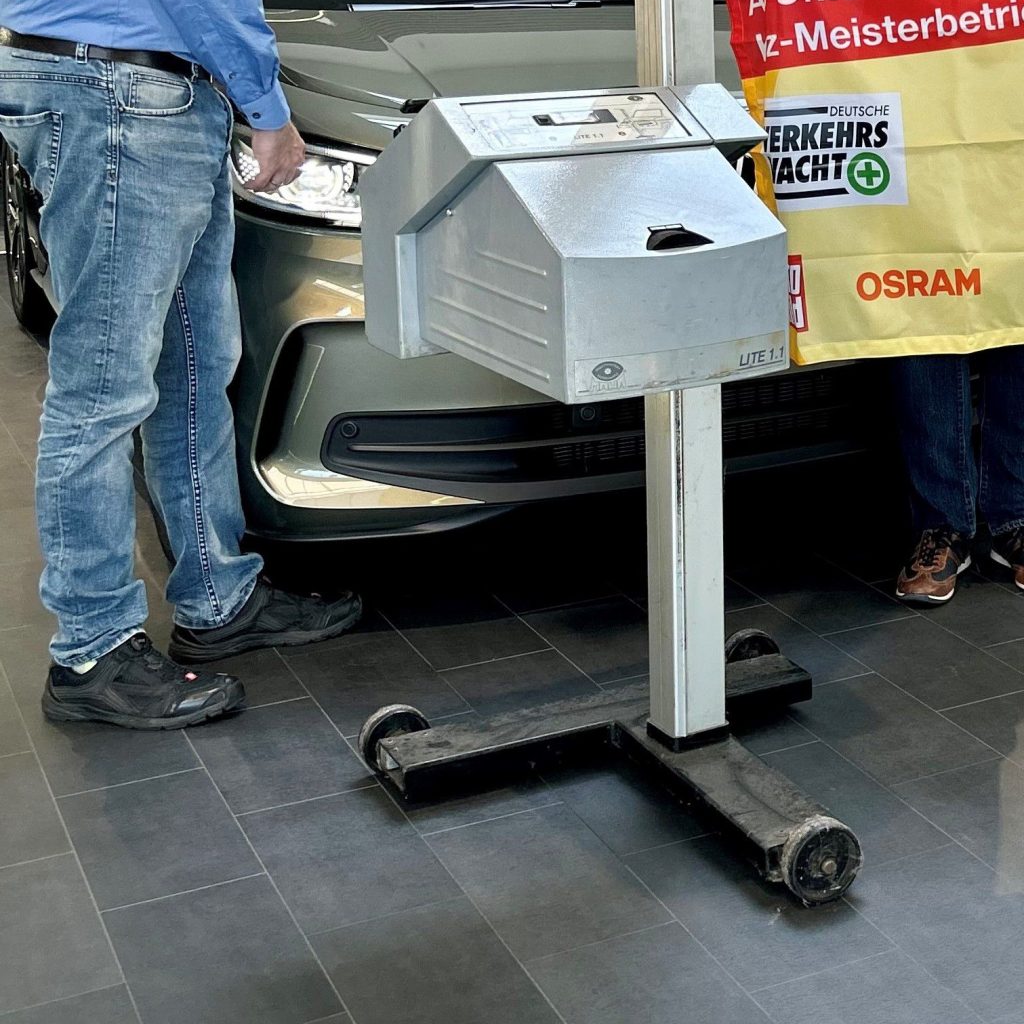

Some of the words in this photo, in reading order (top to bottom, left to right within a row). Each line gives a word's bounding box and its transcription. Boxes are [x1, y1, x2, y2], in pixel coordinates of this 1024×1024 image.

[829, 105, 890, 117] DEUTSCHE
[856, 267, 982, 301] OSRAM
[739, 350, 766, 367] LITE
[769, 346, 785, 362] 1.1
